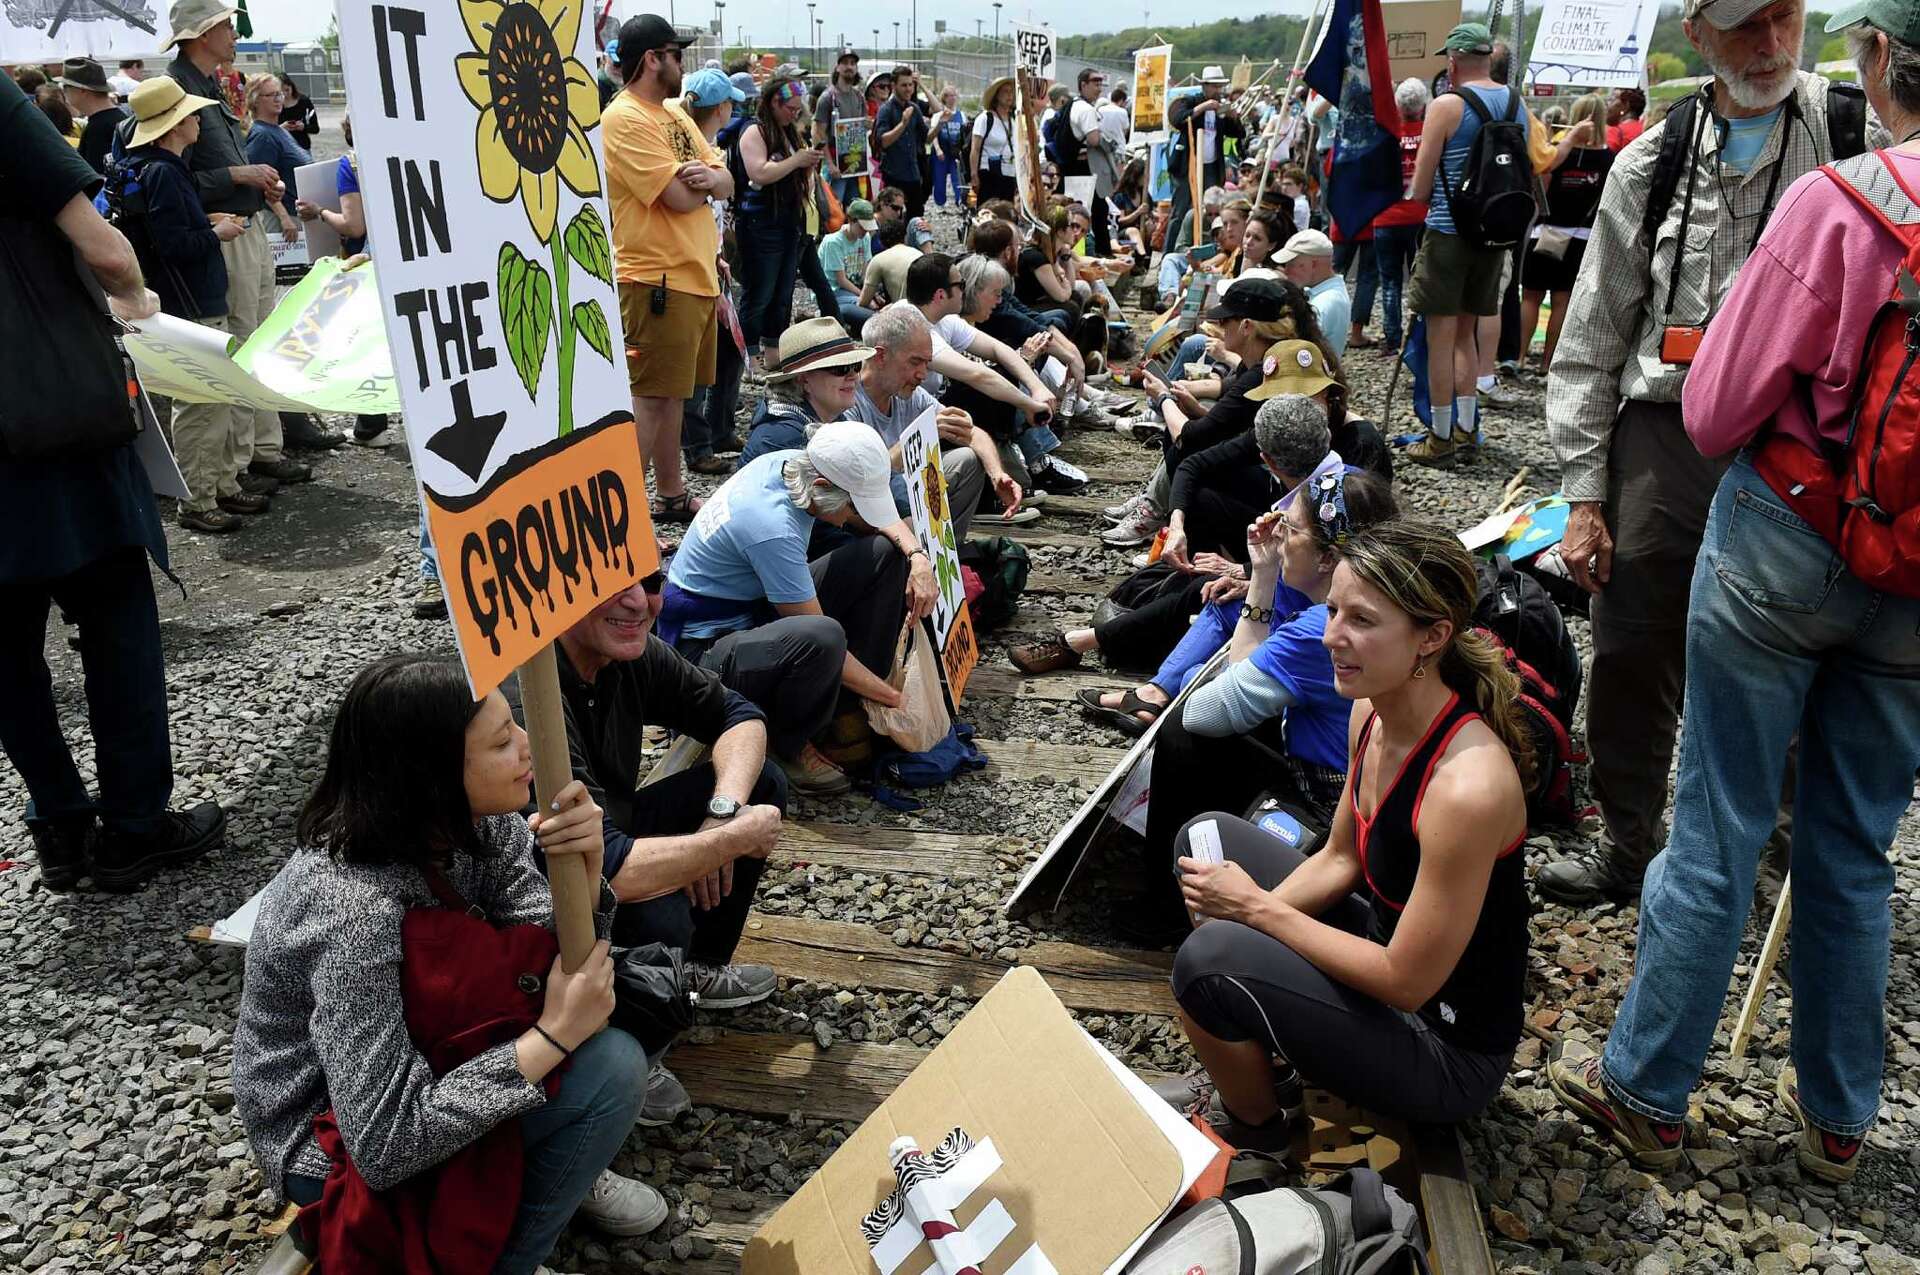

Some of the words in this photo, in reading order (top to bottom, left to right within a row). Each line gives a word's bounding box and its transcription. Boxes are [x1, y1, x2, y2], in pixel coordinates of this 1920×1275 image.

[1550, 21, 1611, 36] CLIMATE
[1562, 5, 1601, 20] FINAL
[1016, 29, 1048, 56] KEEP
[1029, 53, 1038, 65] IN
[1543, 36, 1615, 52] COUNTDOWN
[372, 4, 426, 121] IT
[387, 156, 452, 261] IN
[394, 281, 497, 391] THE
[904, 429, 922, 479] KEEP
[913, 481, 923, 521] IT
[461, 469, 635, 656] GROUND
[1264, 817, 1297, 842] Bernie
